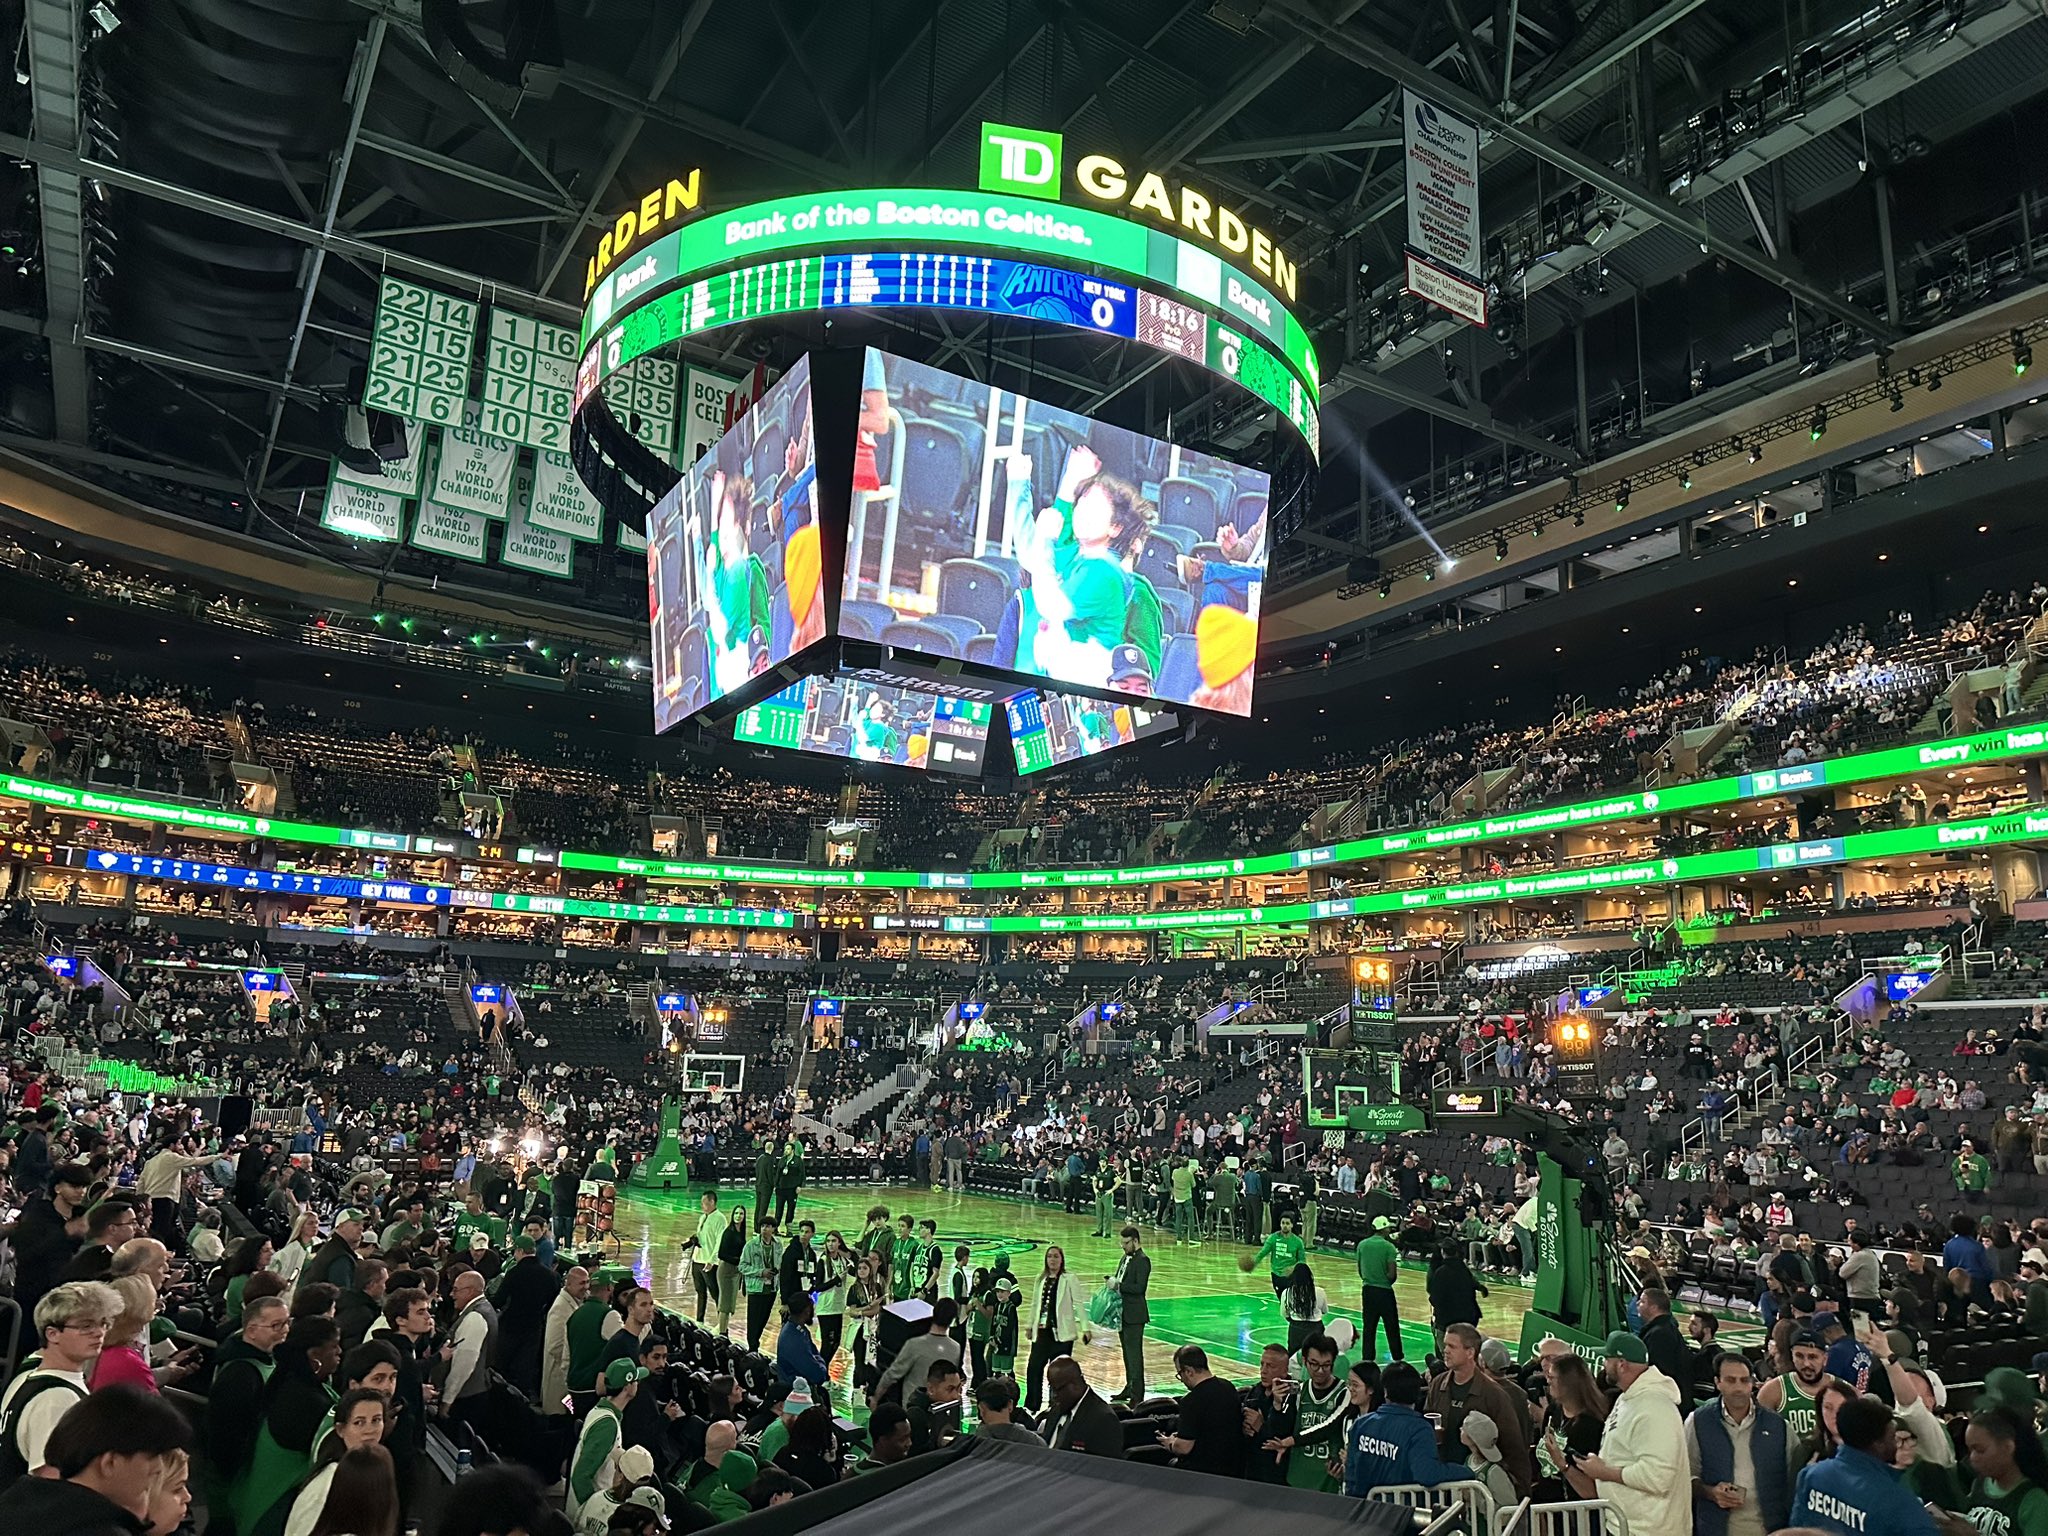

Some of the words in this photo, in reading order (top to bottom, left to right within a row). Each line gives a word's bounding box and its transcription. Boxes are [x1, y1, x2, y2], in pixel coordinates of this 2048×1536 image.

[1417, 130, 1468, 160] CHAMPIONSHIP
[1438, 125, 1467, 143] HOCKEY
[1438, 130, 1455, 144] EAST
[1410, 150, 1437, 170] BOSTON
[1439, 167, 1476, 188] UNIVERSITY
[1414, 143, 1441, 163] BOSTON
[1443, 160, 1470, 178] COLLEGE
[1430, 170, 1456, 189] UCONN
[1432, 182, 1454, 198] MAINE
[1416, 182, 1470, 214] MASSACHUSETTS
[1419, 192, 1442, 210] UMASS
[1444, 205, 1469, 222] LOWELL
[725, 210, 788, 245] Bank
[792, 205, 822, 230] of
[825, 203, 871, 228] the
[876, 200, 980, 228] Boston
[984, 206, 1093, 246] Celtics.
[988, 134, 1054, 184] TD
[1076, 154, 1297, 302] GARDEN
[1418, 210, 1434, 222] NEW
[1435, 220, 1472, 243] HAMPSHIRE
[1420, 221, 1470, 251] NORTHEASTERN
[1424, 233, 1466, 258] PROVIDENCE
[1430, 244, 1462, 264] VERMONT
[616, 256, 657, 300] Bank
[1414, 264, 1440, 285] Boston
[1442, 278, 1478, 304] University
[384, 282, 426, 316] 22
[1228, 278, 1272, 326] Bank
[1436, 288, 1478, 315] Champions
[437, 300, 470, 328] 14
[1091, 298, 1114, 328] 0
[1149, 299, 1199, 332] 18:16
[380, 314, 420, 346] 23
[505, 318, 517, 342] 1
[544, 329, 575, 356] 16
[432, 329, 466, 359] 15
[607, 342, 620, 370] 0
[376, 347, 414, 378] 21
[496, 346, 528, 374] 19
[538, 355, 574, 386] LOSCY
[639, 358, 674, 386] 33
[1222, 346, 1238, 374] 0
[422, 360, 464, 391] 25
[369, 379, 411, 412] 24
[492, 378, 526, 404] 17
[536, 390, 569, 418] 18
[637, 387, 672, 415] 35
[430, 396, 450, 420] 6
[487, 408, 521, 437] 10
[540, 422, 560, 447] 2
[638, 418, 667, 445] 31
[465, 458, 488, 474] 1974
[440, 479, 504, 505] CHAMPIONS
[456, 470, 494, 489] WORLD
[558, 482, 580, 498] 1969
[347, 496, 385, 513] WORLD
[535, 502, 596, 527] CHAMPIONS
[549, 493, 586, 512] WORLD
[332, 505, 396, 527] CHAMPIONS
[434, 515, 471, 532] WORLD
[421, 524, 480, 547] CHAMPIONS
[522, 533, 557, 550] WORLD
[510, 541, 566, 564] CHAMPIONS
[93, 652, 112, 662] 307
[1682, 648, 1700, 658] 315
[604, 682, 631, 692] RAFTERS
[855, 668, 994, 699] Putnam
[1495, 696, 1510, 706] 314
[954, 748, 977, 762] Bank
[1918, 742, 1971, 764] Every
[1973, 737, 2004, 752] win
[2007, 730, 2044, 748] has
[1754, 774, 1775, 790] TD
[1779, 770, 1813, 786] Bank
[1383, 836, 1410, 850] Every
[1410, 834, 1426, 846] win
[1486, 818, 1517, 834] Every
[1938, 824, 1988, 844] Every
[1991, 820, 2022, 835] win
[1775, 846, 1794, 862] TD
[1798, 844, 1832, 860] Bank
[646, 864, 664, 873] win
[1048, 873, 1063, 883] win
[360, 882, 382, 897] NEW
[385, 884, 412, 900] YORK
[426, 889, 438, 902] 0
[504, 894, 516, 908] 0
[1402, 892, 1430, 906] Every
[1429, 890, 1446, 901] win
[1506, 880, 1536, 894] Every
[1066, 917, 1082, 927] win
[1800, 921, 1822, 932] 141
[1542, 942, 1556, 952] 139
[1366, 1010, 1394, 1020] TISSOT
[1567, 1063, 1594, 1072] TISSOT
[1458, 1093, 1483, 1105] Sports
[1377, 1108, 1404, 1120] Sports
[1540, 1216, 1548, 1259] BOSTON
[1546, 1221, 1559, 1270] Sports
[694, 1342, 702, 1360] G
[1544, 1331, 1596, 1360] Bton
[744, 1368, 754, 1388] G
[1358, 1434, 1398, 1460] SECURITY
[1808, 1489, 1867, 1532] SECURITY
